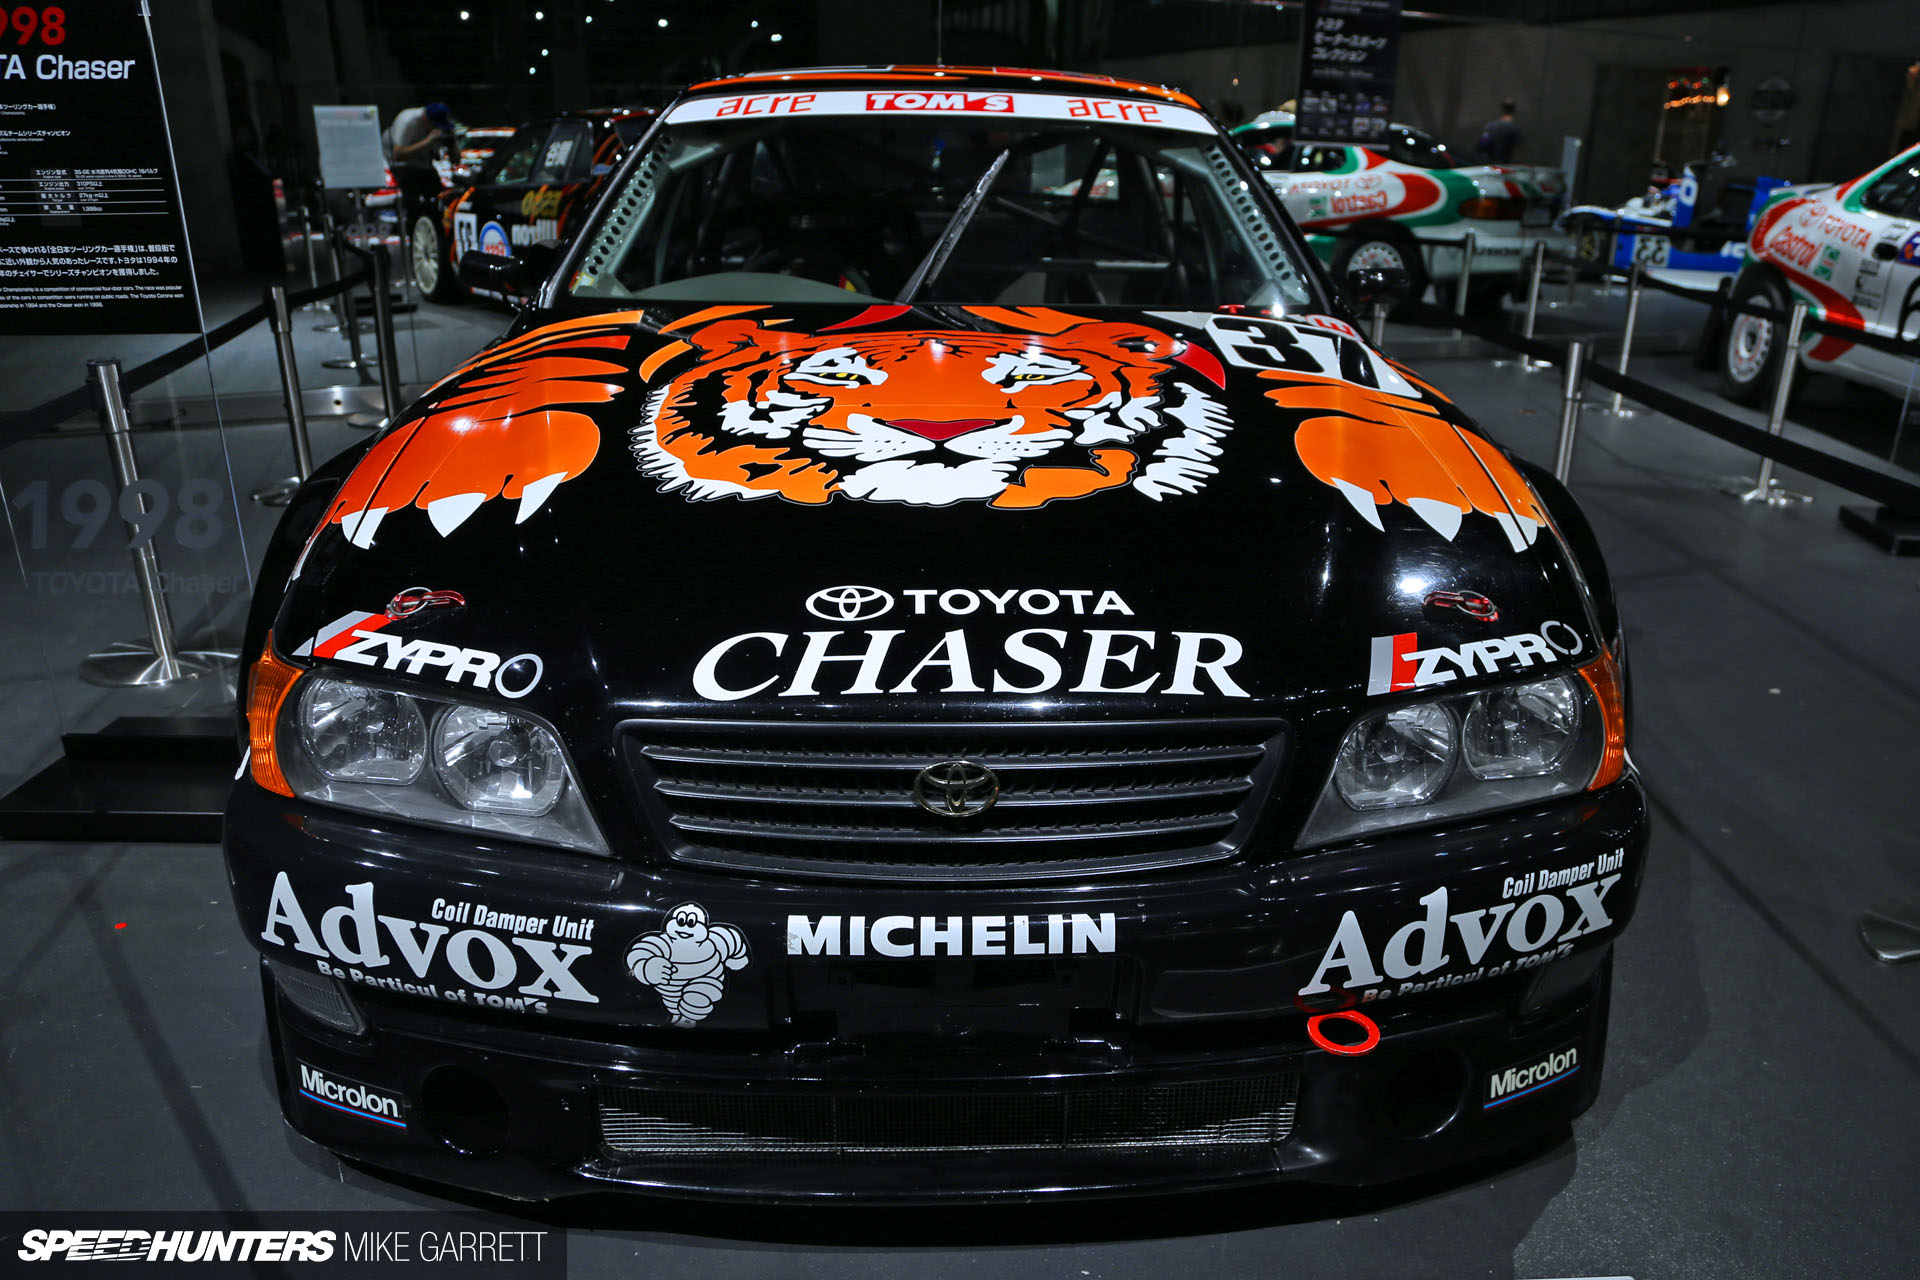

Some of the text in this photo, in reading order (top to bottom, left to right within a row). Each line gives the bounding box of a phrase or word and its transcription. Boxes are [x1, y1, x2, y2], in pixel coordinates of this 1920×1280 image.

[36, 54, 135, 80] Chaser
[716, 93, 816, 118] acre
[1069, 99, 1164, 123] acre
[1769, 226, 1824, 269] Castrol
[1819, 215, 1872, 251] TOYOTA
[1212, 316, 1381, 389] 37
[12, 478, 225, 550] 1998
[30, 571, 137, 594] TOYOTA
[903, 588, 1135, 616] TOYOTA
[333, 629, 544, 699] ZYPRO
[692, 628, 1251, 701] CHASER
[1401, 620, 1583, 687] ZYPRO
[1503, 848, 1625, 899] Coil Damper Unit
[261, 871, 600, 1004] Advox
[431, 898, 595, 942] Coil Damper Unit
[786, 912, 1117, 957] MICHELIN
[1298, 873, 1622, 996] Advox
[316, 960, 346, 980] Be
[350, 968, 439, 999] Particul
[444, 989, 467, 1005] of
[1362, 988, 1392, 1004] Be
[1400, 970, 1484, 998] Particul
[1488, 961, 1511, 977] of
[300, 1064, 399, 1118] Microlon
[1490, 1047, 1577, 1098] Microlon
